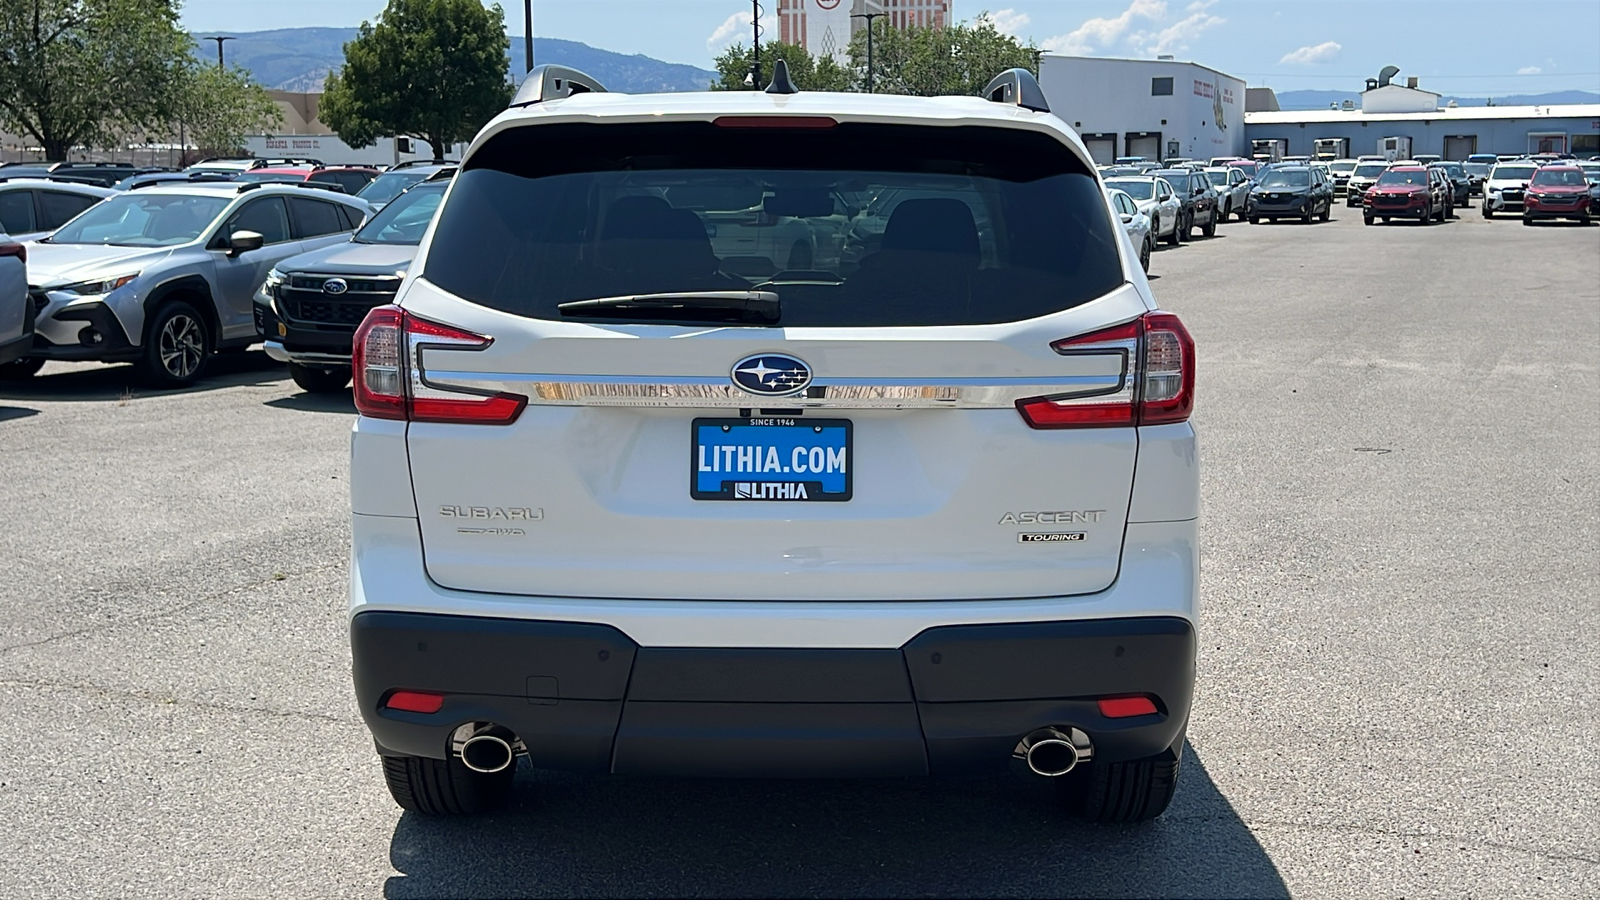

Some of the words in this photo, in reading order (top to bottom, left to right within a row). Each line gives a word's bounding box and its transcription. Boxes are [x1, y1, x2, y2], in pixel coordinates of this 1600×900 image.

[750, 418, 774, 426] SINCE
[776, 418, 795, 426] 1946
[698, 445, 847, 474] LITHIA.COM
[751, 482, 808, 499] LITHIA
[439, 505, 545, 521] SUBARU
[998, 509, 1107, 525] ASCENT
[1026, 533, 1080, 541] TOURING
